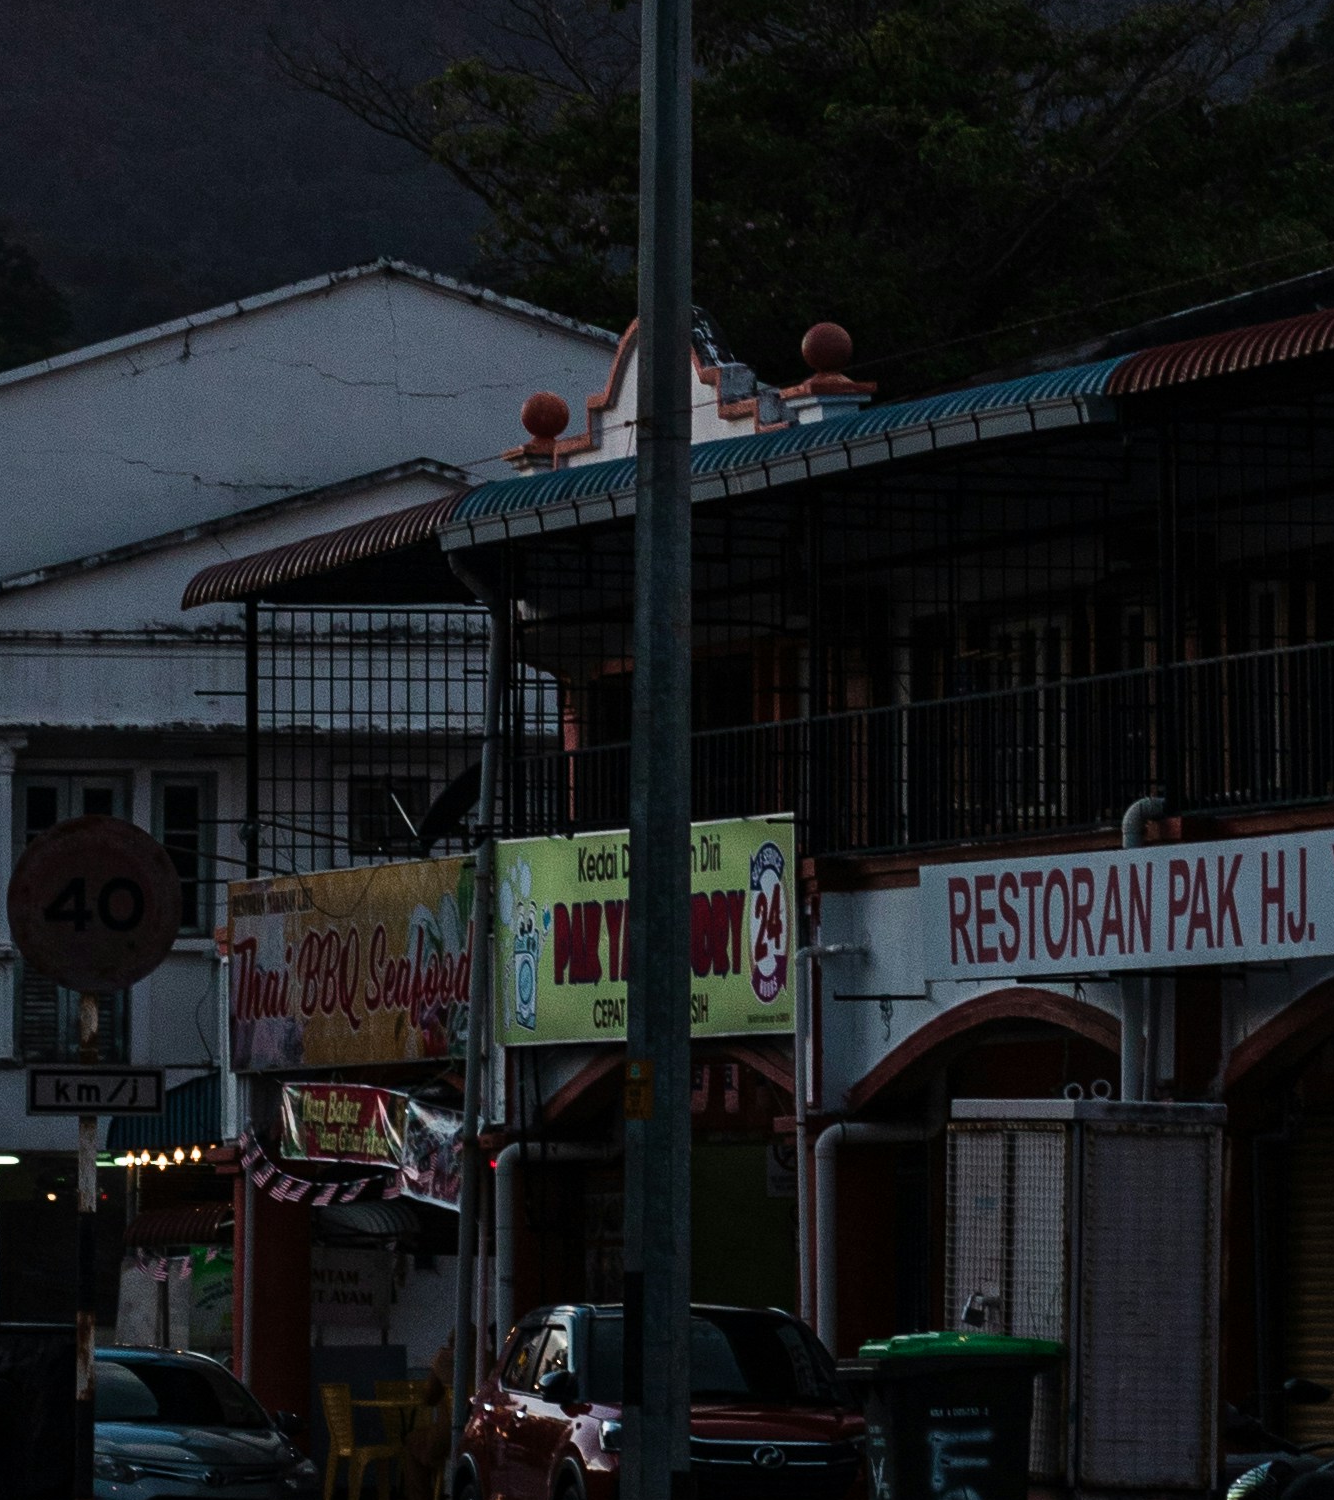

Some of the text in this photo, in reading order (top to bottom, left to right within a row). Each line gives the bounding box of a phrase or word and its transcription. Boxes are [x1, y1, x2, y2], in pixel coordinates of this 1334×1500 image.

[578, 845, 617, 882] Kedai
[700, 834, 722, 871] Diri
[44, 877, 145, 932] 40
[755, 883, 782, 962] 24
[948, 862, 1153, 965] RESTORAN
[1168, 854, 1244, 952] PAK
[1261, 847, 1316, 945] HJ.
[233, 920, 474, 1030] Thai BBQ Seafood
[594, 999, 625, 1028] CEPAT
[55, 1078, 139, 1105] km/j
